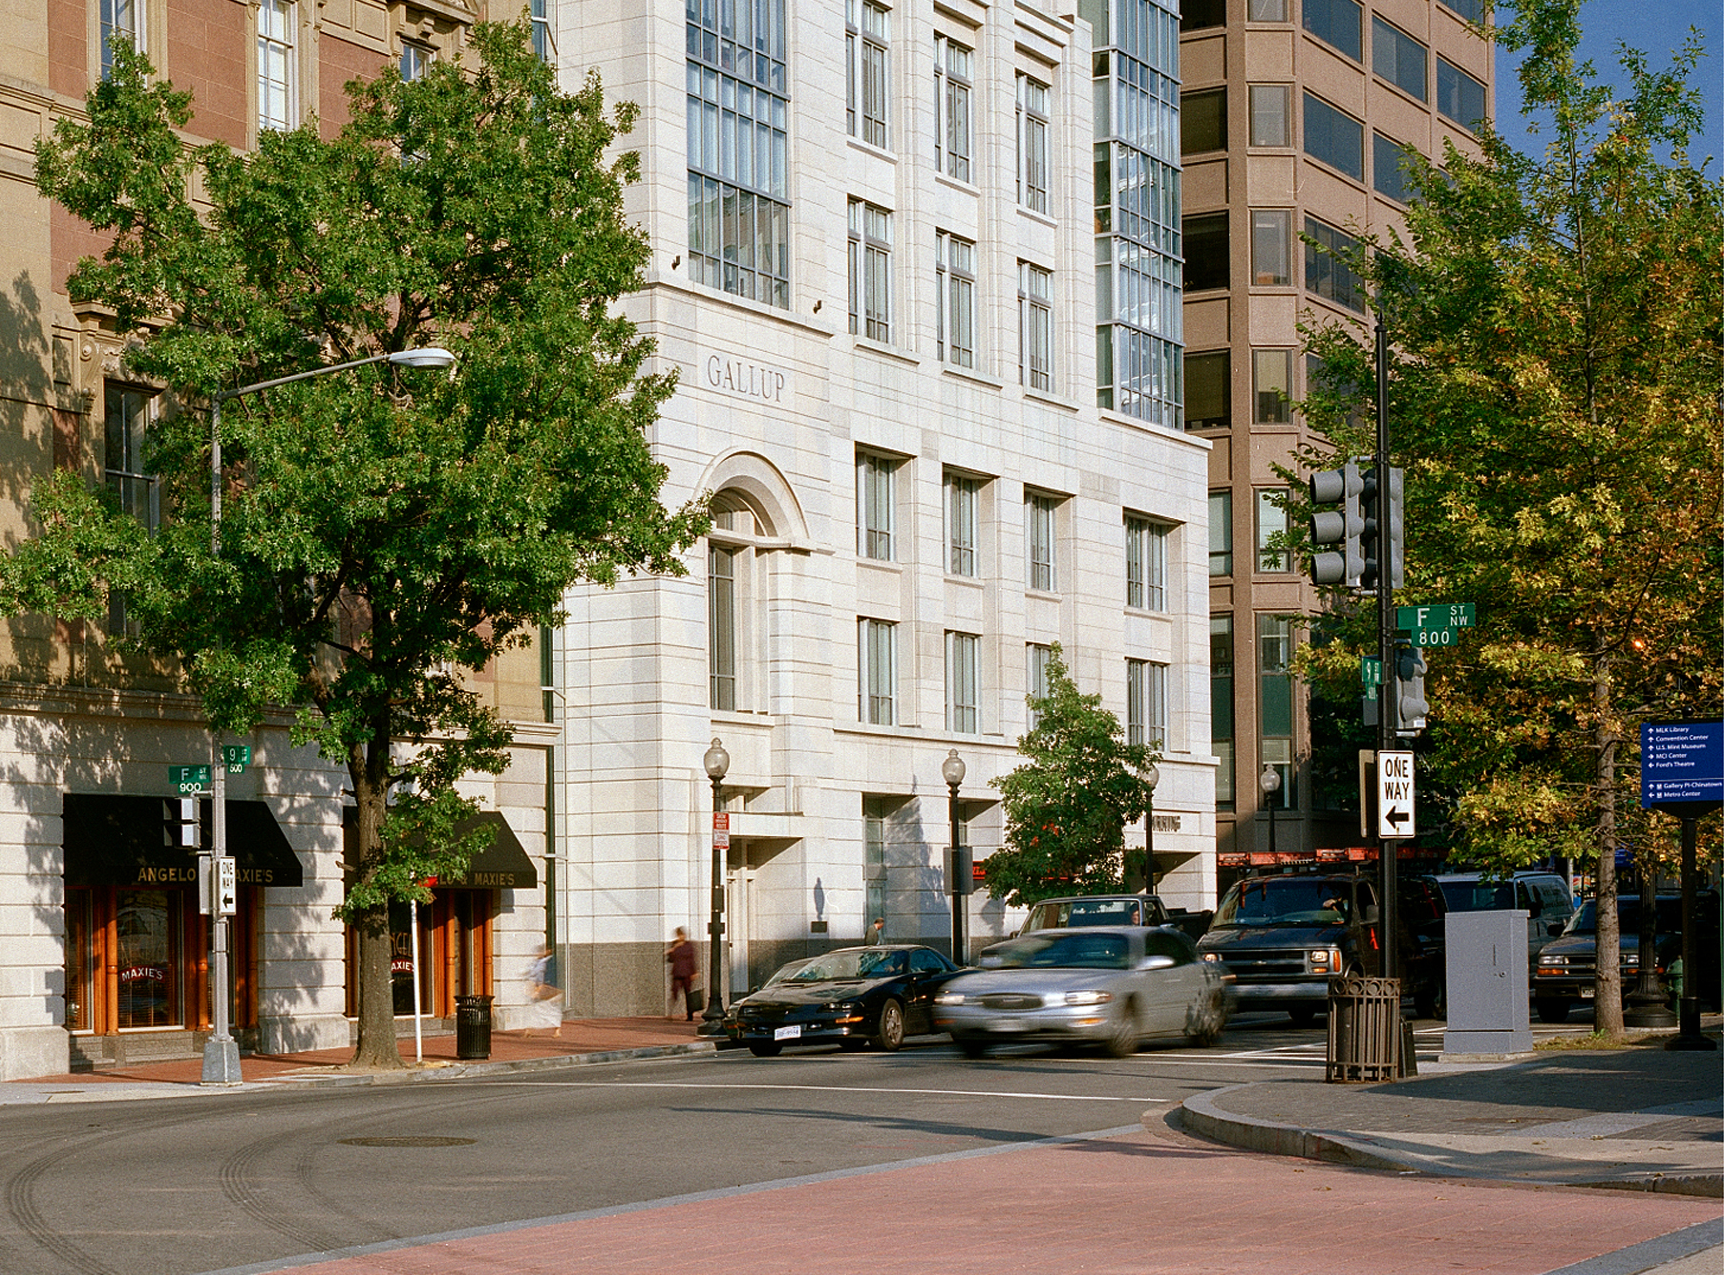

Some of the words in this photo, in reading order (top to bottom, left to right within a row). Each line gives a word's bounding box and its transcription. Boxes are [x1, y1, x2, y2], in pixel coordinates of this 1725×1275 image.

[707, 354, 785, 403] GALLUP
[1417, 607, 1430, 627] F
[1450, 605, 1465, 615] ST
[1450, 616, 1468, 626] NW
[1419, 631, 1450, 645] 800
[229, 748, 236, 761] 9
[181, 768, 189, 781] F
[1385, 758, 1409, 778] ONE
[179, 782, 202, 793] 900
[1384, 782, 1410, 800] WAY
[137, 867, 196, 882] ANGELO
[234, 869, 274, 883] AXIE'S
[222, 861, 233, 876] ONE
[475, 873, 515, 886] MAXIE'S
[390, 932, 413, 956] NGEL
[391, 960, 415, 972] AXIE
[121, 967, 163, 982] MAXIE'S
